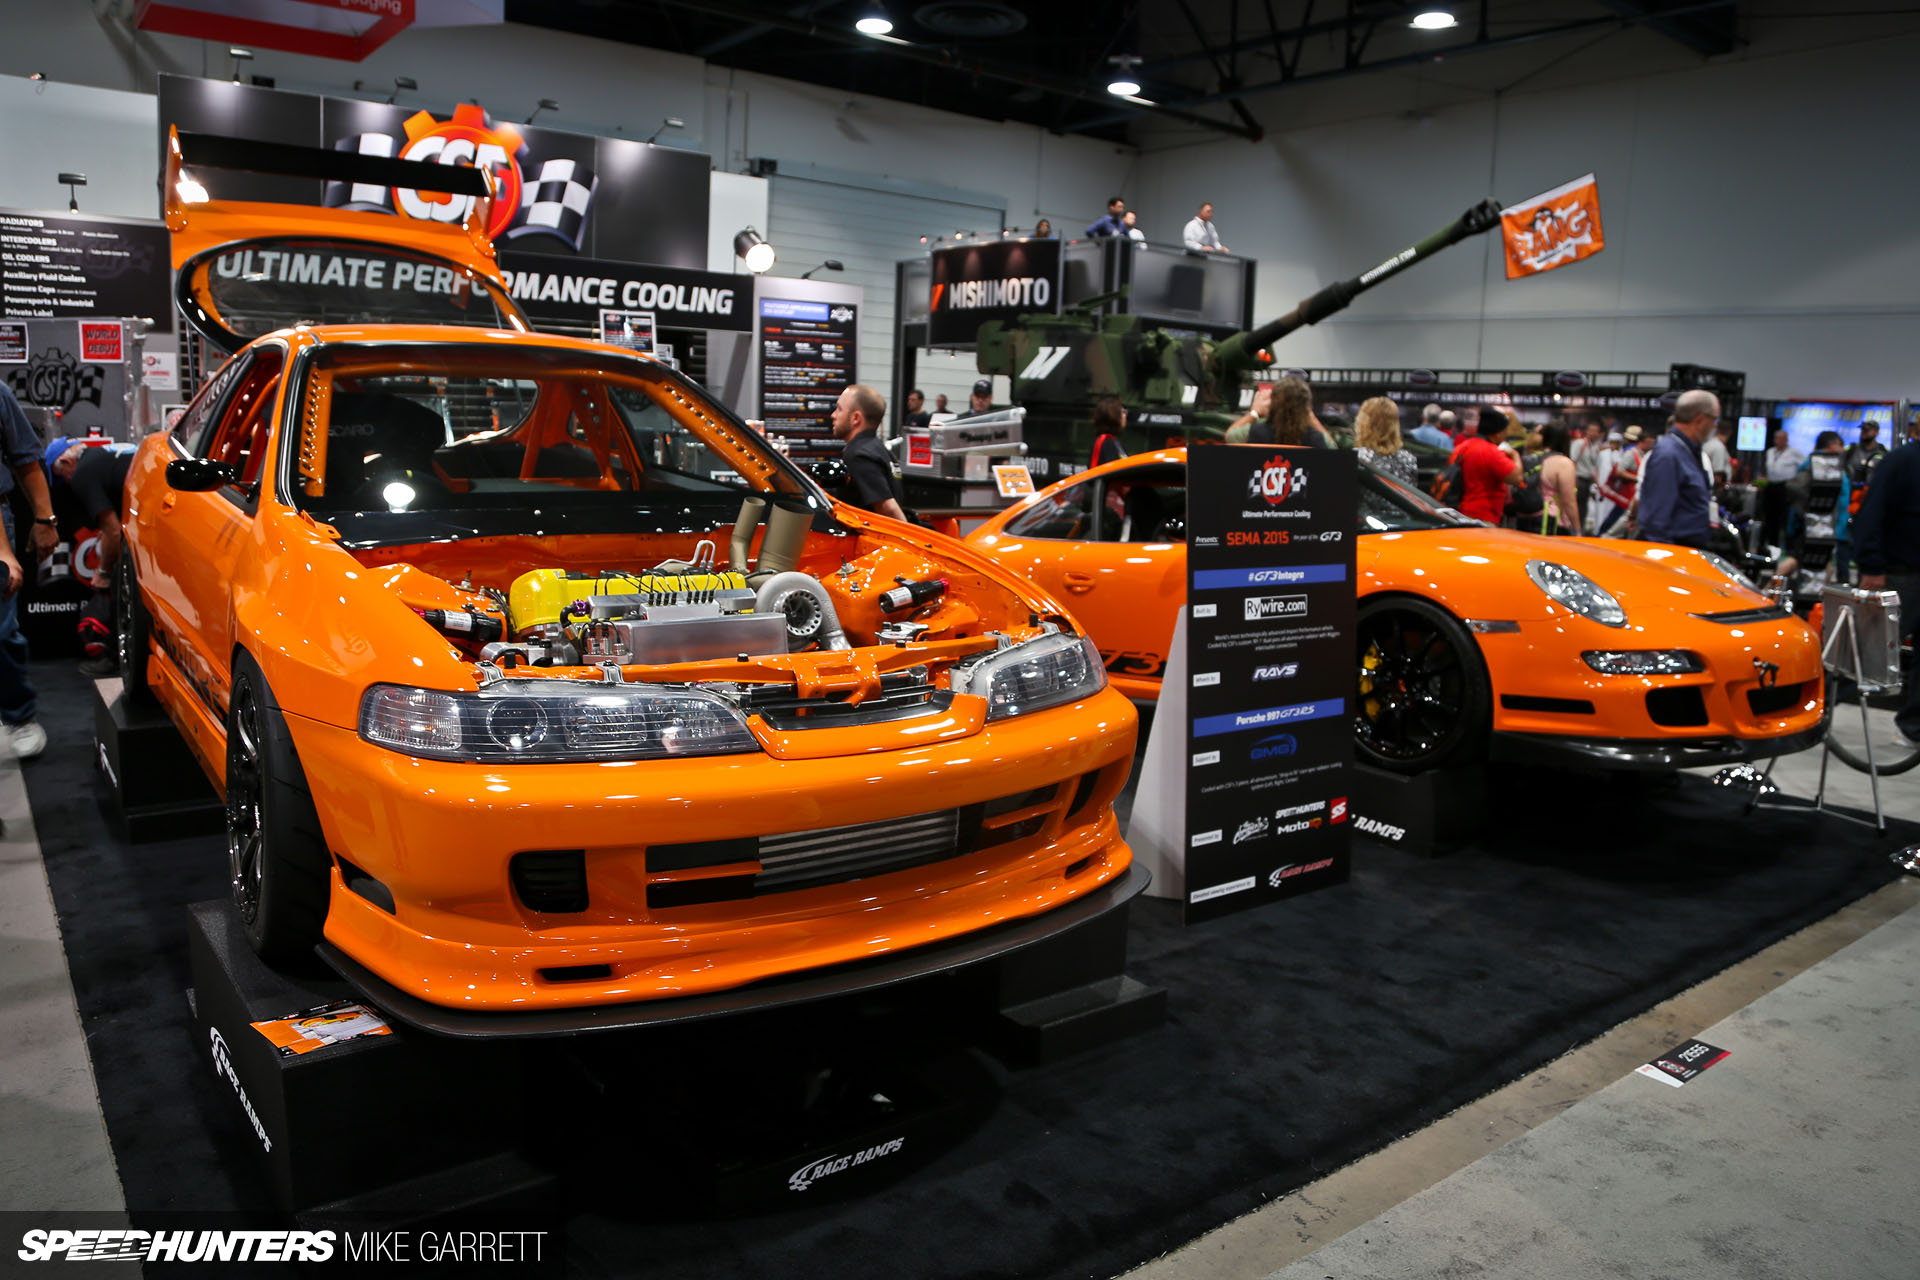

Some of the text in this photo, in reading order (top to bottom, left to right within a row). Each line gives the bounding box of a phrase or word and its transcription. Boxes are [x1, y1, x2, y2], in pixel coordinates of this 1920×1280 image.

[0, 216, 44, 228] RADIATORS
[1, 235, 57, 246] INTERCOOLERS
[2, 253, 51, 264] OIL COOLERS
[3, 270, 86, 283] Auxiliary Fluid Coolers
[216, 250, 386, 289] ULTIMATE
[622, 281, 734, 315] COOLING
[4, 283, 37, 293] Pressure
[38, 285, 56, 295] Caps
[949, 277, 1050, 309] MISHIMOTO
[5, 308, 54, 318] Private Label
[86, 329, 119, 340] WORLD
[87, 343, 118, 354] DEBUT
[33, 365, 72, 403] CSF
[1262, 467, 1288, 496] CSF
[1226, 532, 1261, 546] SEMA
[1263, 531, 1289, 545] 2015
[1320, 531, 1342, 541] GT3
[28, 602, 77, 613] Ultimate
[1247, 599, 1306, 616] Rywire.com
[1253, 664, 1298, 680] RAYS
[1236, 713, 1266, 726] Porsche
[1275, 800, 1326, 819] SPEEDHUNTERS
[1354, 816, 1406, 841] RAMPS
[240, 1086, 272, 1153] RAMPS
[810, 1137, 905, 1180] RACE RAMPS
